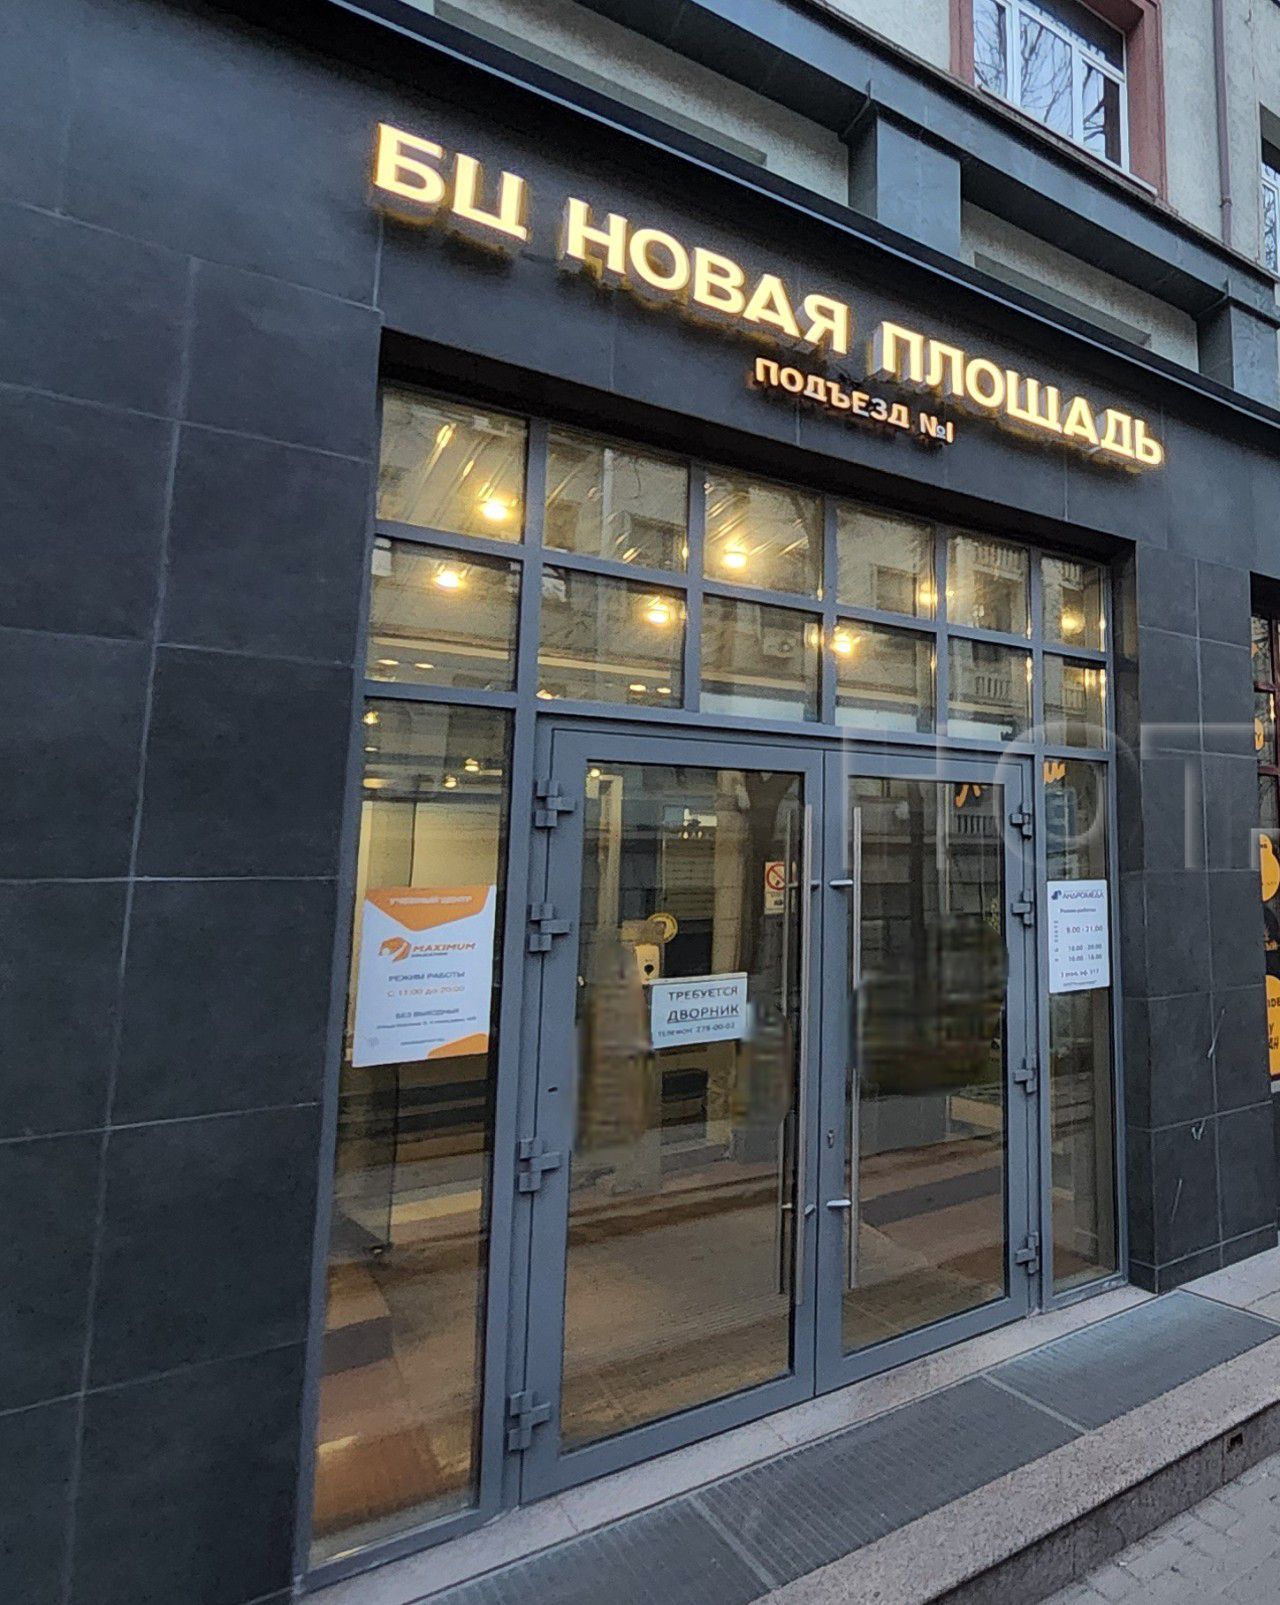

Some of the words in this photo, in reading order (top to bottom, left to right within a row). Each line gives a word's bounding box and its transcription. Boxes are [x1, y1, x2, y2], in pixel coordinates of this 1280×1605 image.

[372, 122, 528, 241] БЦ
[564, 196, 850, 355] НОВАЯ
[874, 321, 1166, 467] ПЛОЩАДЬ
[754, 356, 910, 430] ПОДЪЕЗД
[412, 942, 477, 953] MAXIMUM
[388, 972, 426, 983] РЕЖИМ
[426, 971, 466, 981] РАБОТЫ
[668, 985, 738, 1001] ТРЕБУЕТСЯ
[667, 1004, 740, 1024] ДВОРНИК
